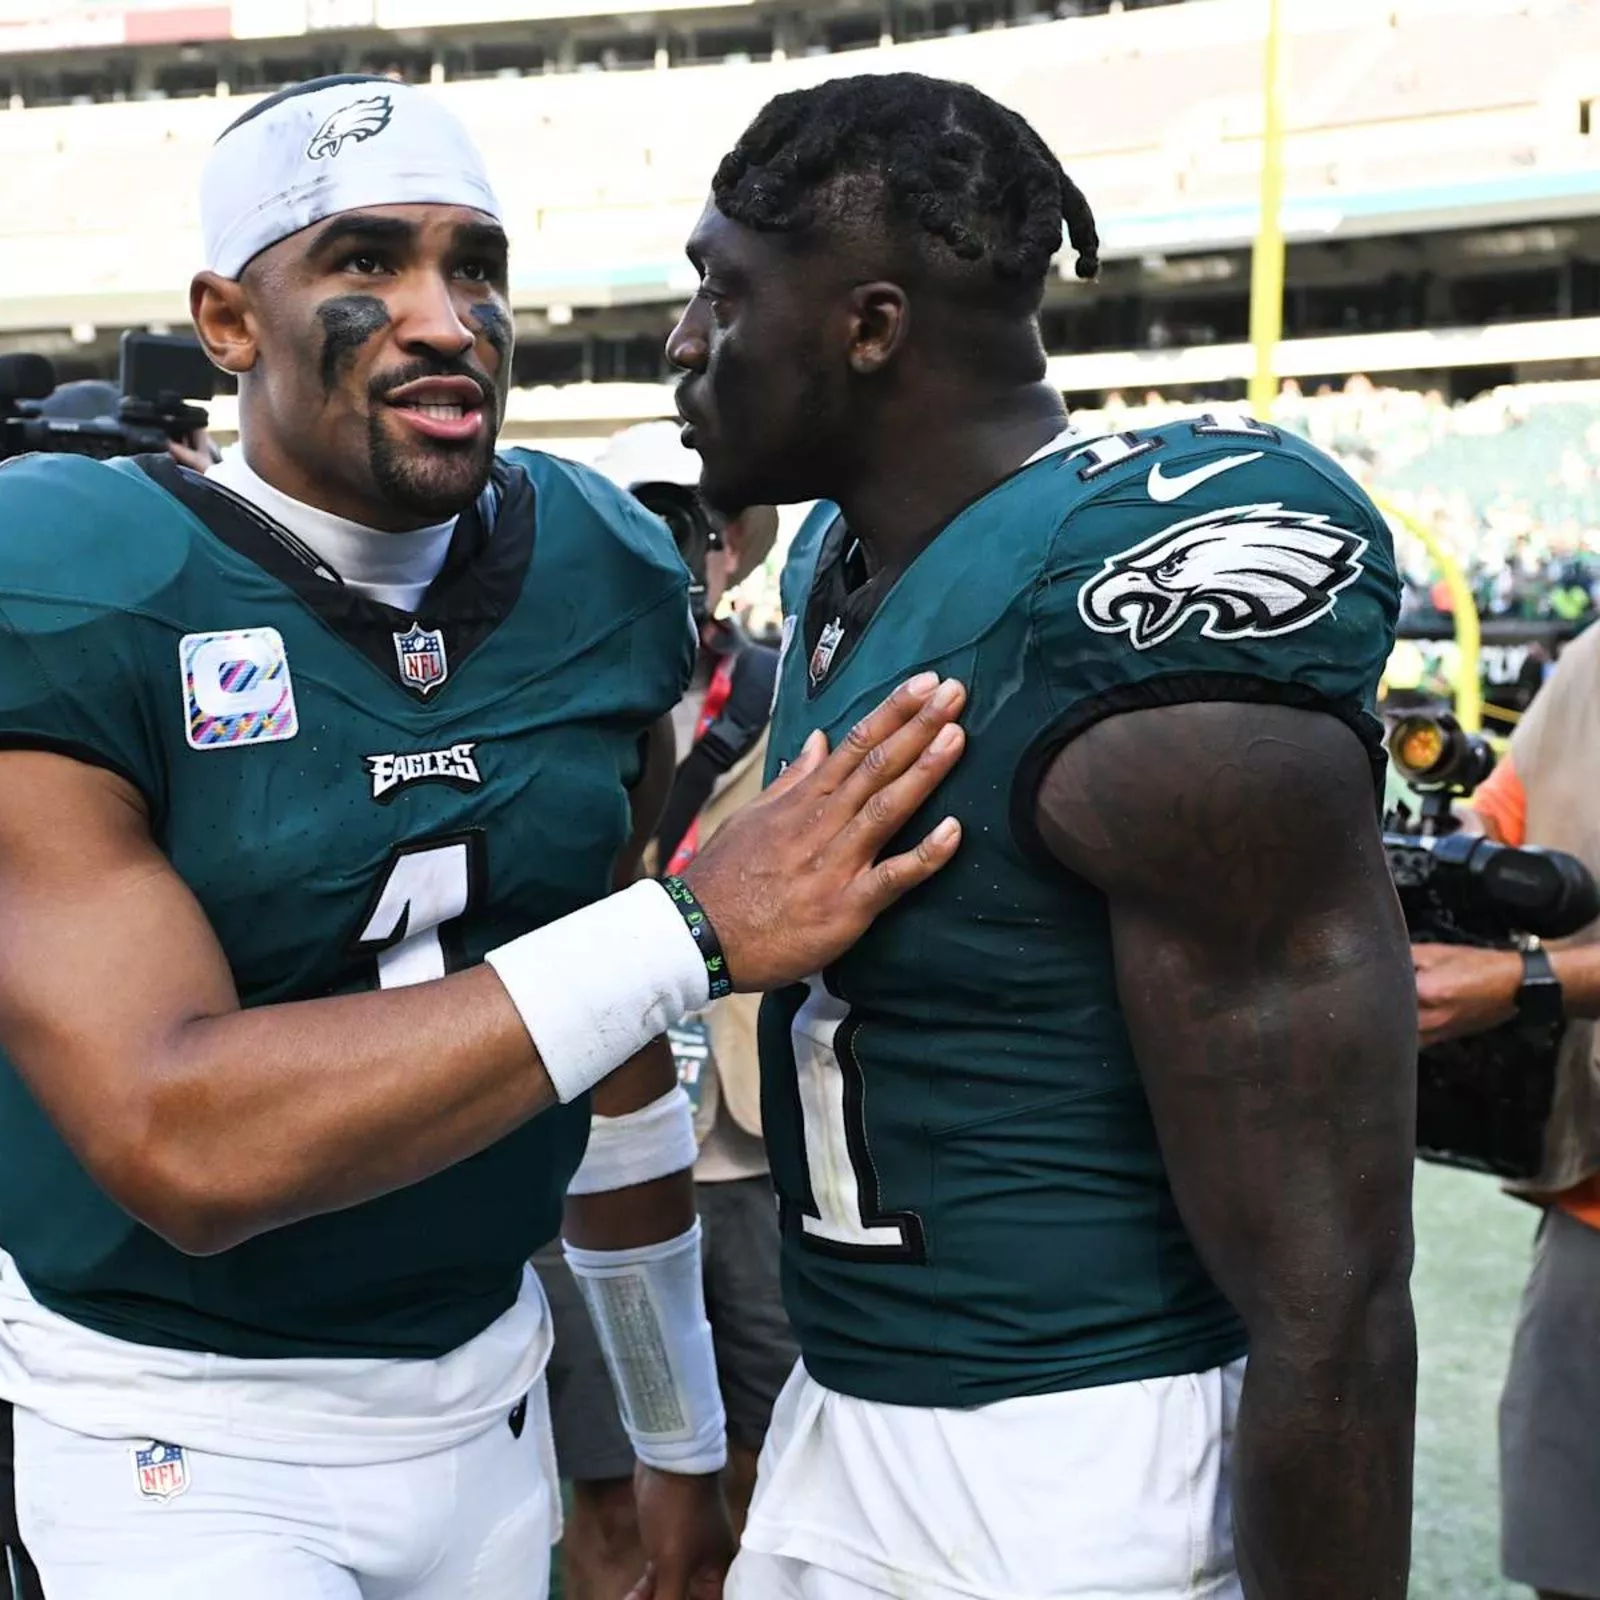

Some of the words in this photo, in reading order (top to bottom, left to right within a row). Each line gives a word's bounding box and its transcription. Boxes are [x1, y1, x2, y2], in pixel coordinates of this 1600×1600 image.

[407, 654, 440, 680] NFL
[366, 743, 481, 798] EAGLES
[359, 843, 468, 990] 1
[142, 1463, 182, 1490] NFL
